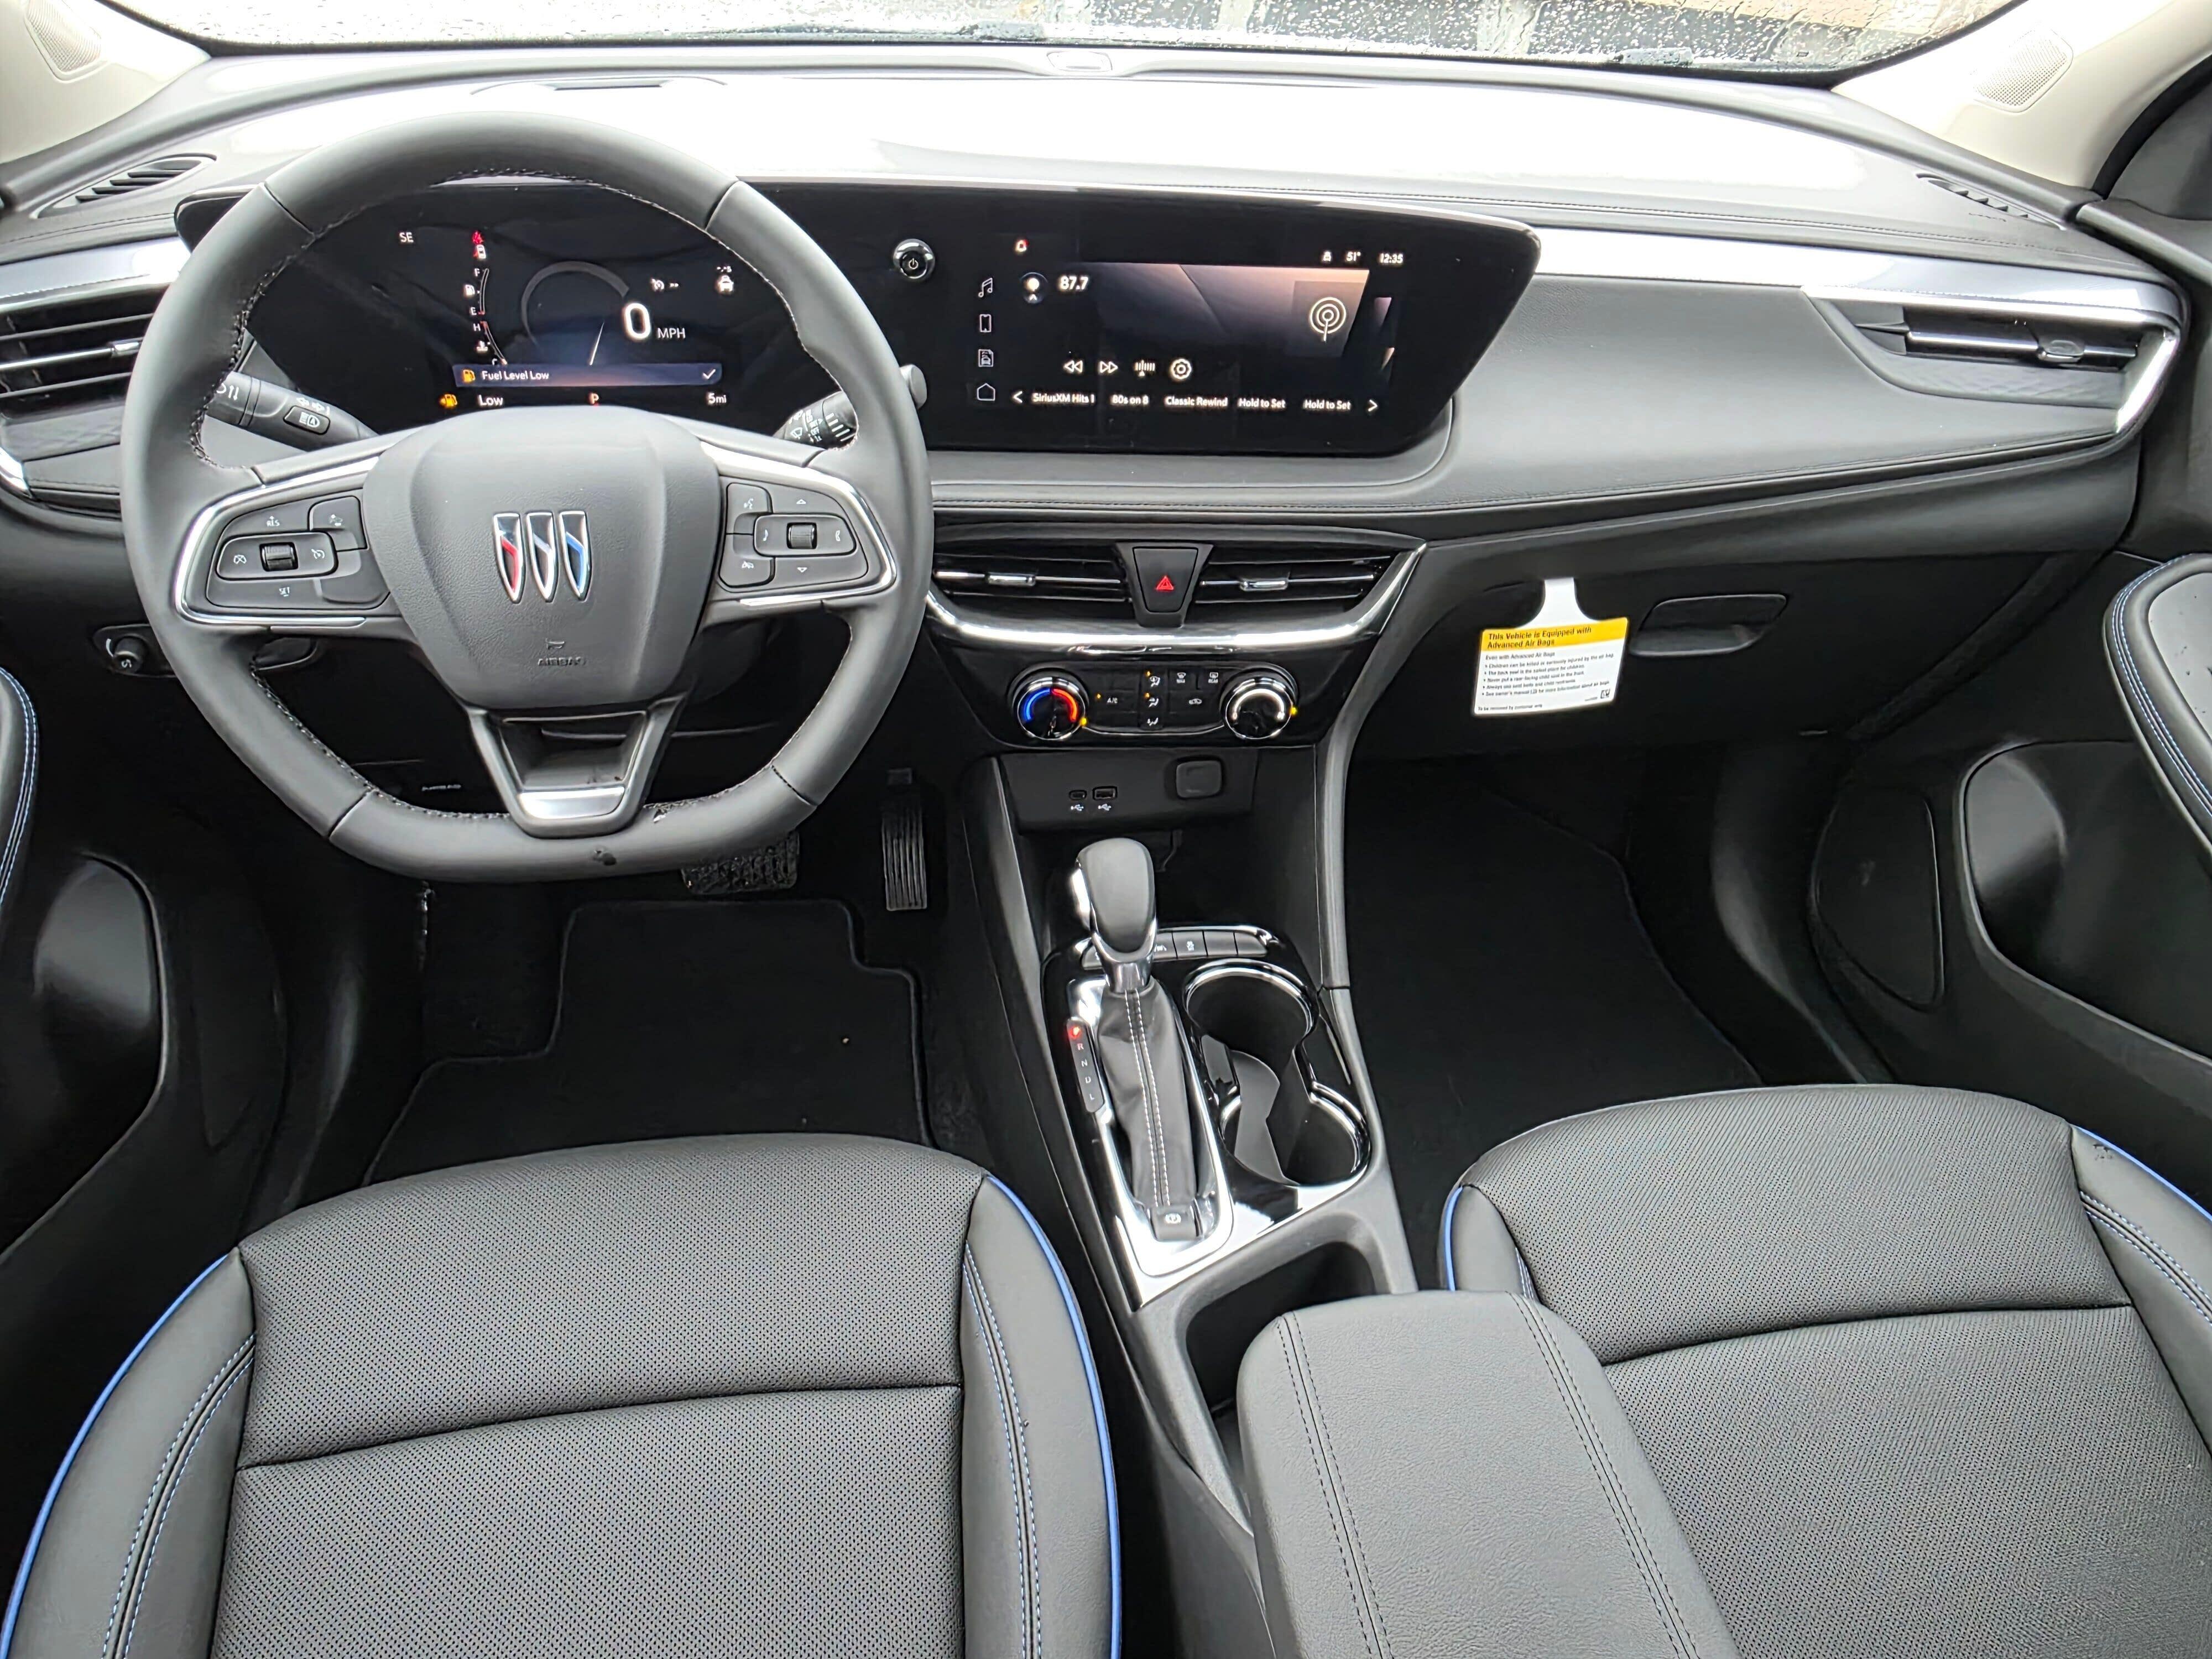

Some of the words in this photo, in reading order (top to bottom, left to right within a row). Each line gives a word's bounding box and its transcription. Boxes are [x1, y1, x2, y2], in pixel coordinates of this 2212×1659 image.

[399, 232, 414, 243] SE
[1379, 253, 1404, 264] 12:35
[474, 268, 480, 276] F
[1058, 275, 1089, 290] 87.7
[470, 306, 477, 316] E
[623, 302, 651, 340] 0
[473, 323, 481, 331] H
[657, 327, 686, 339] MPH
[482, 370, 502, 380] Fuel
[503, 370, 529, 380] Level
[529, 370, 549, 380] Low
[478, 394, 503, 406] Low
[589, 392, 599, 405] P
[706, 392, 727, 404] 5mi
[1032, 392, 1071, 404] SiriusXM
[1072, 393, 1090, 404] Hits
[1112, 394, 1129, 404] 80s
[1142, 394, 1149, 405] 8
[1165, 396, 1195, 406] Classic
[1196, 396, 1228, 407] Rewind
[1238, 397, 1259, 408] Hold
[1260, 398, 1270, 408] to
[1271, 399, 1286, 409] Set
[1305, 399, 1325, 409] Hold
[1326, 400, 1335, 410] to
[1336, 400, 1351, 410] Set
[1542, 628, 1574, 638] Equipped
[1525, 639, 1535, 648] Air
[1077, 1042, 1084, 1051] R
[1081, 1058, 1088, 1067] N
[1084, 1076, 1092, 1084] D
